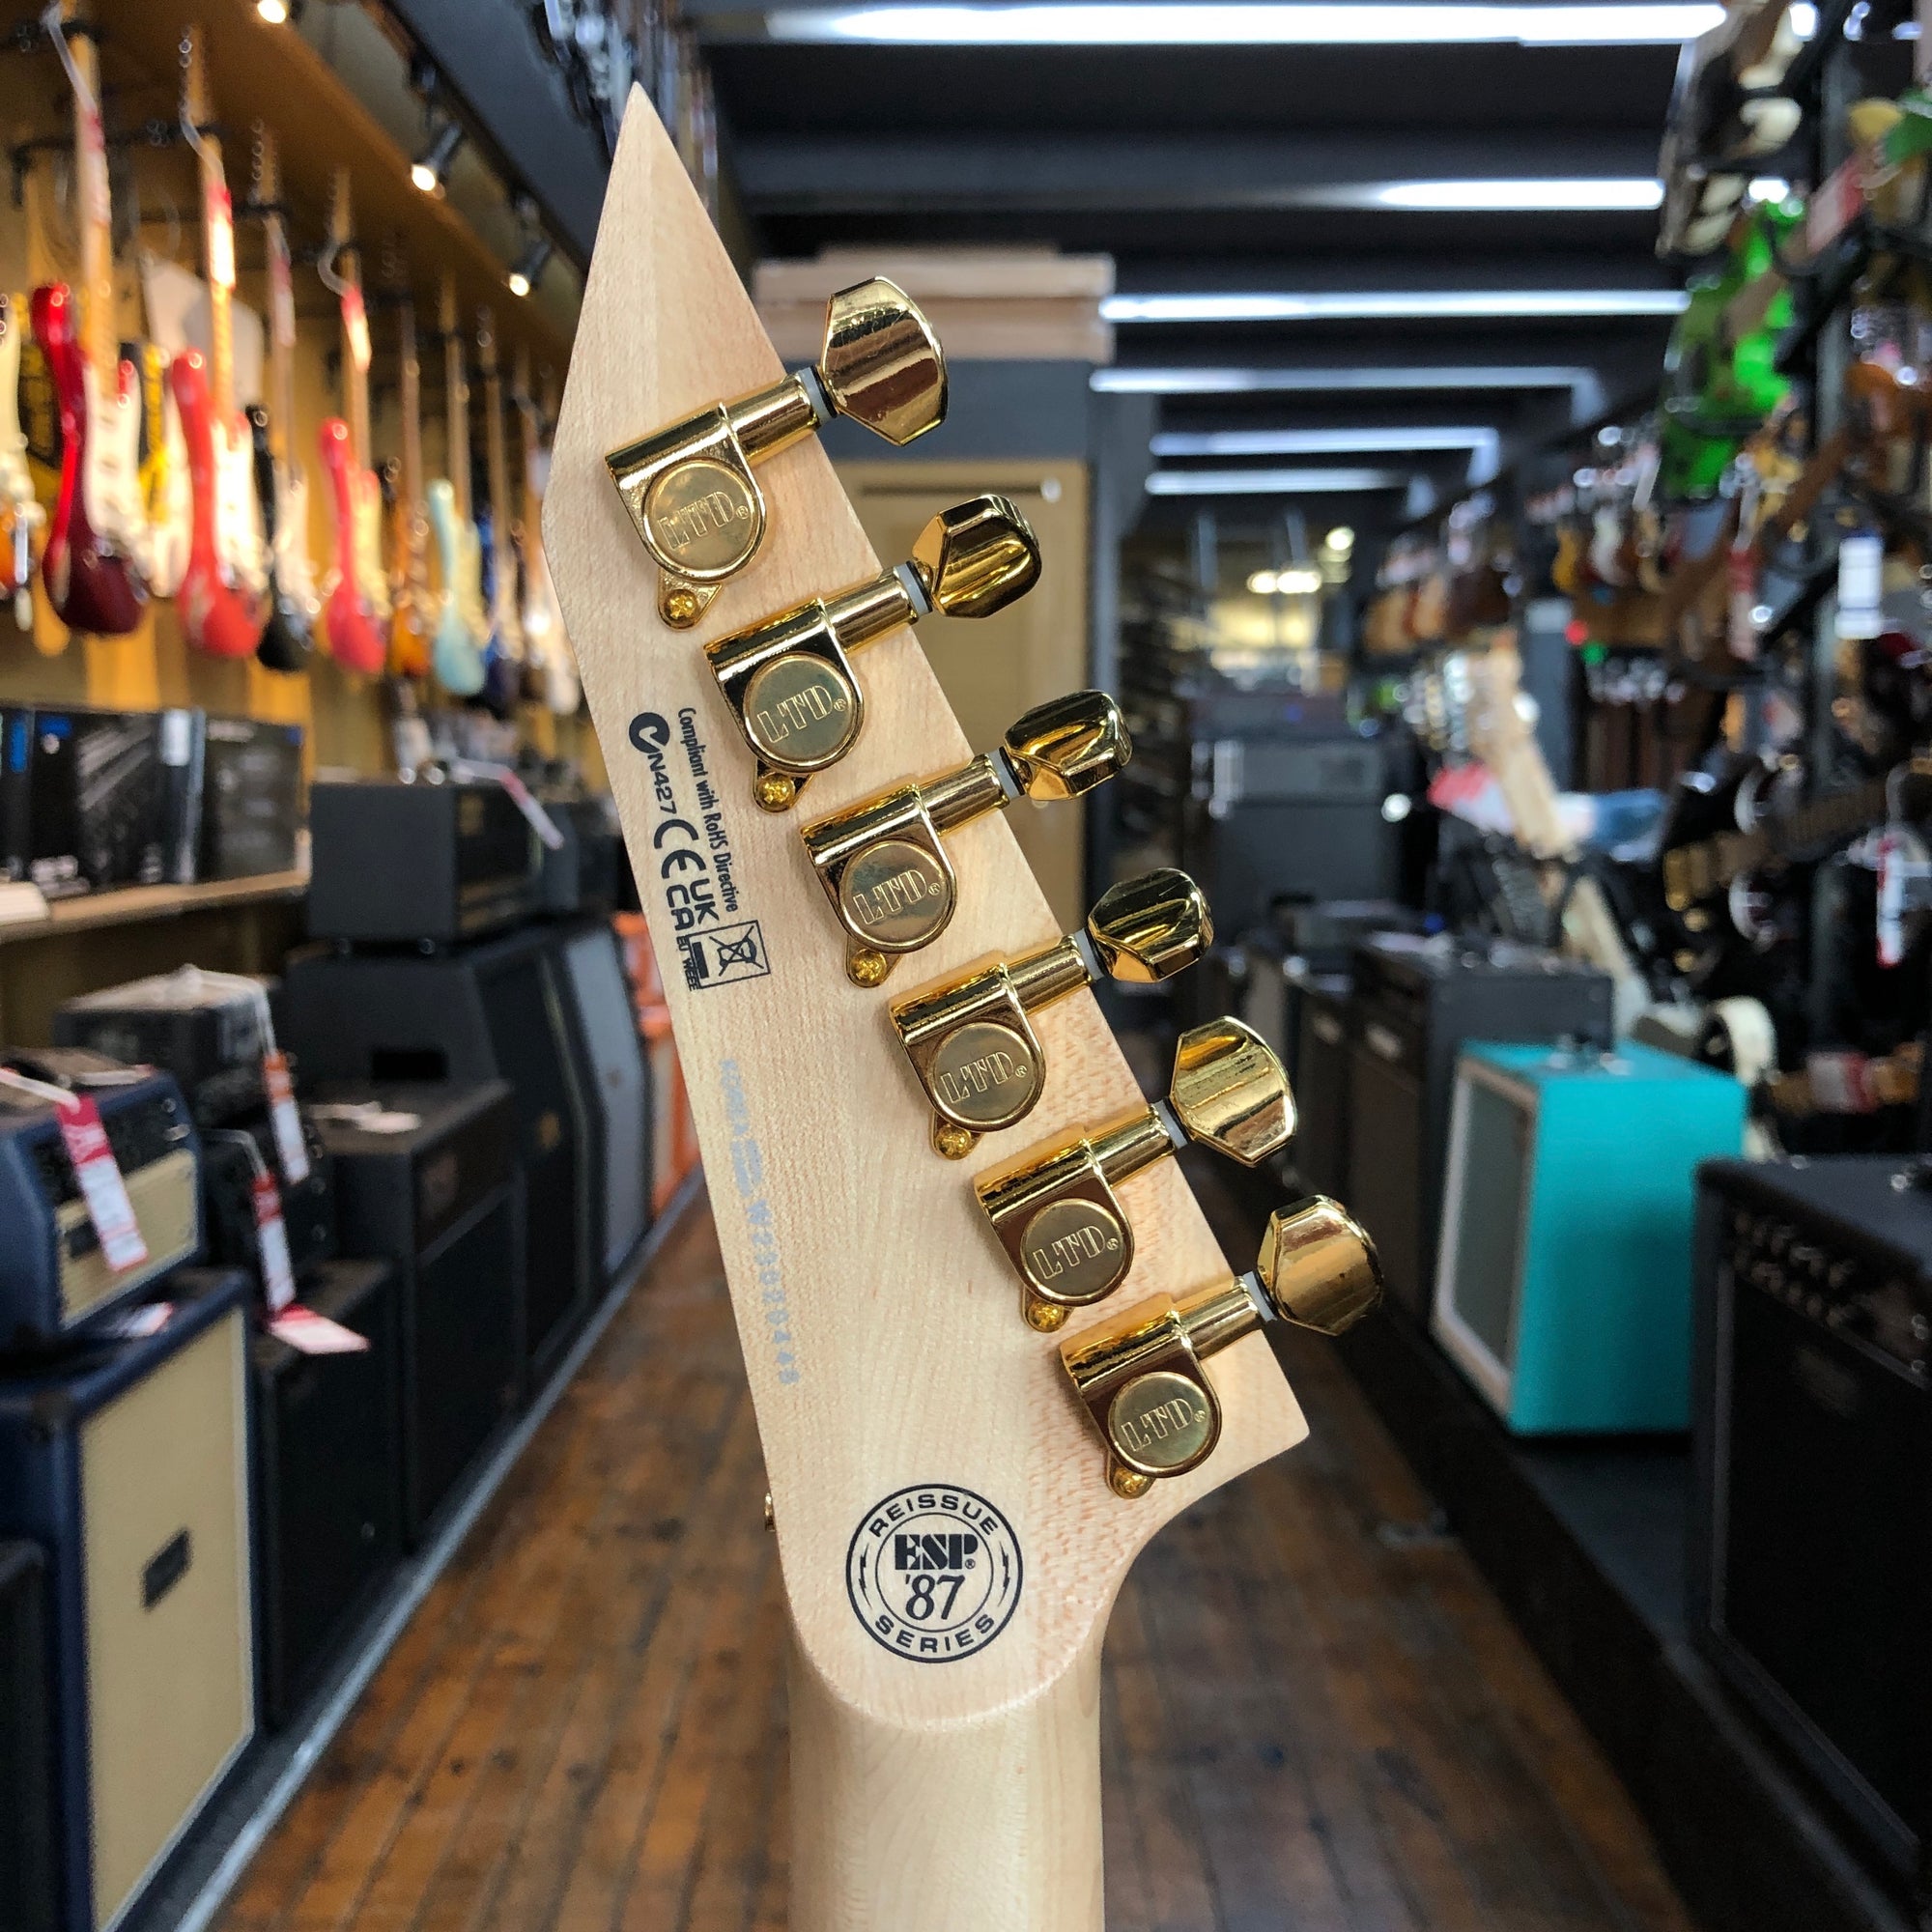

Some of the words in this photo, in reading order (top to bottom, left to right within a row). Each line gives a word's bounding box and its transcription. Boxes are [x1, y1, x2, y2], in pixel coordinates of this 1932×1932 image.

[678, 707, 708, 777] Compliant
[696, 780, 720, 810] with
[703, 812, 728, 850] RoHS
[690, 878, 720, 925] UK
[713, 853, 740, 912] Directive
[666, 884, 695, 931] CA
[869, 1493, 999, 1538] REISSUE
[905, 1574, 965, 1621] '87
[875, 1613, 995, 1653] SERIES
